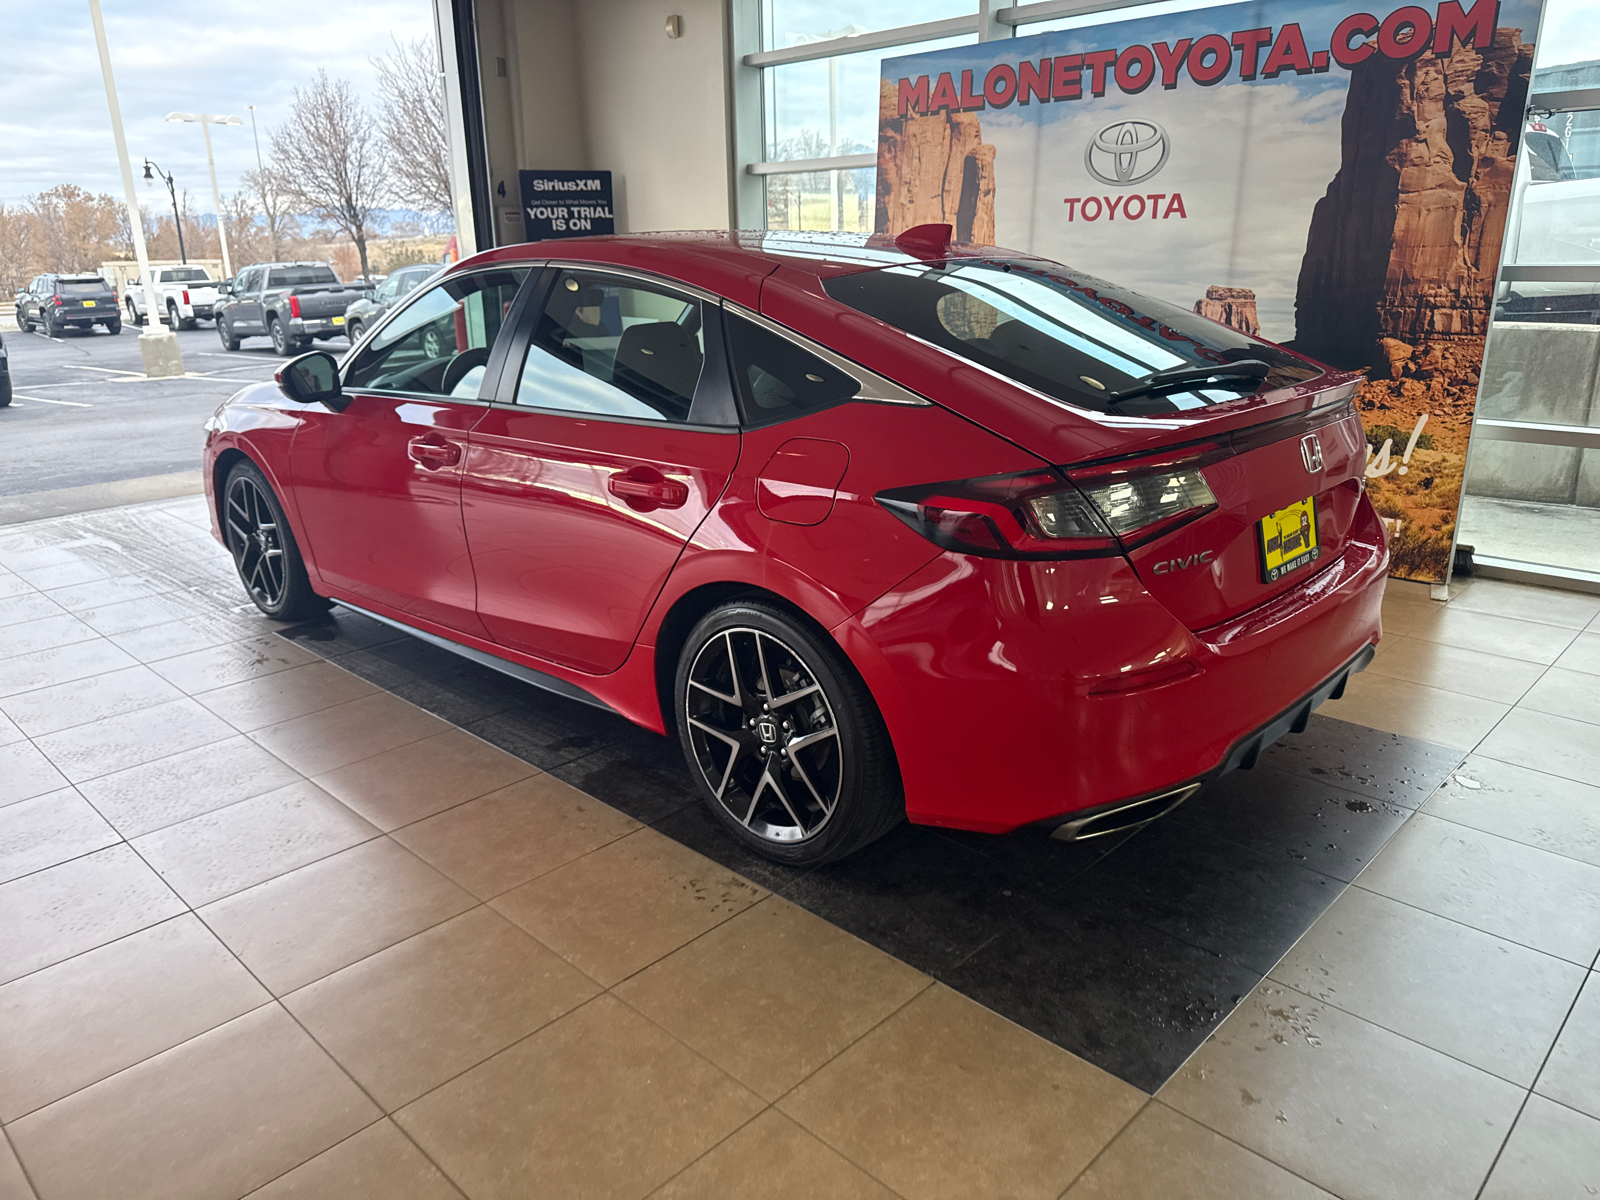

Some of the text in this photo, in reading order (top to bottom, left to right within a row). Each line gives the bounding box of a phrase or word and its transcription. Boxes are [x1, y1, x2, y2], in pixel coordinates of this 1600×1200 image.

[897, 0, 1500, 116] MALONETOYOTA.COM
[533, 179, 601, 191] SiriusXM
[526, 207, 568, 219] YOUR
[570, 206, 613, 218] TRIAL
[1063, 193, 1187, 222] TOYOTA
[552, 219, 591, 231] IS ON
[1301, 515, 1307, 526] 32
[1153, 550, 1213, 575] CIVIC
[1280, 566, 1287, 575] WE
[1287, 560, 1297, 572] MAKE
[1301, 553, 1310, 565] EASY
